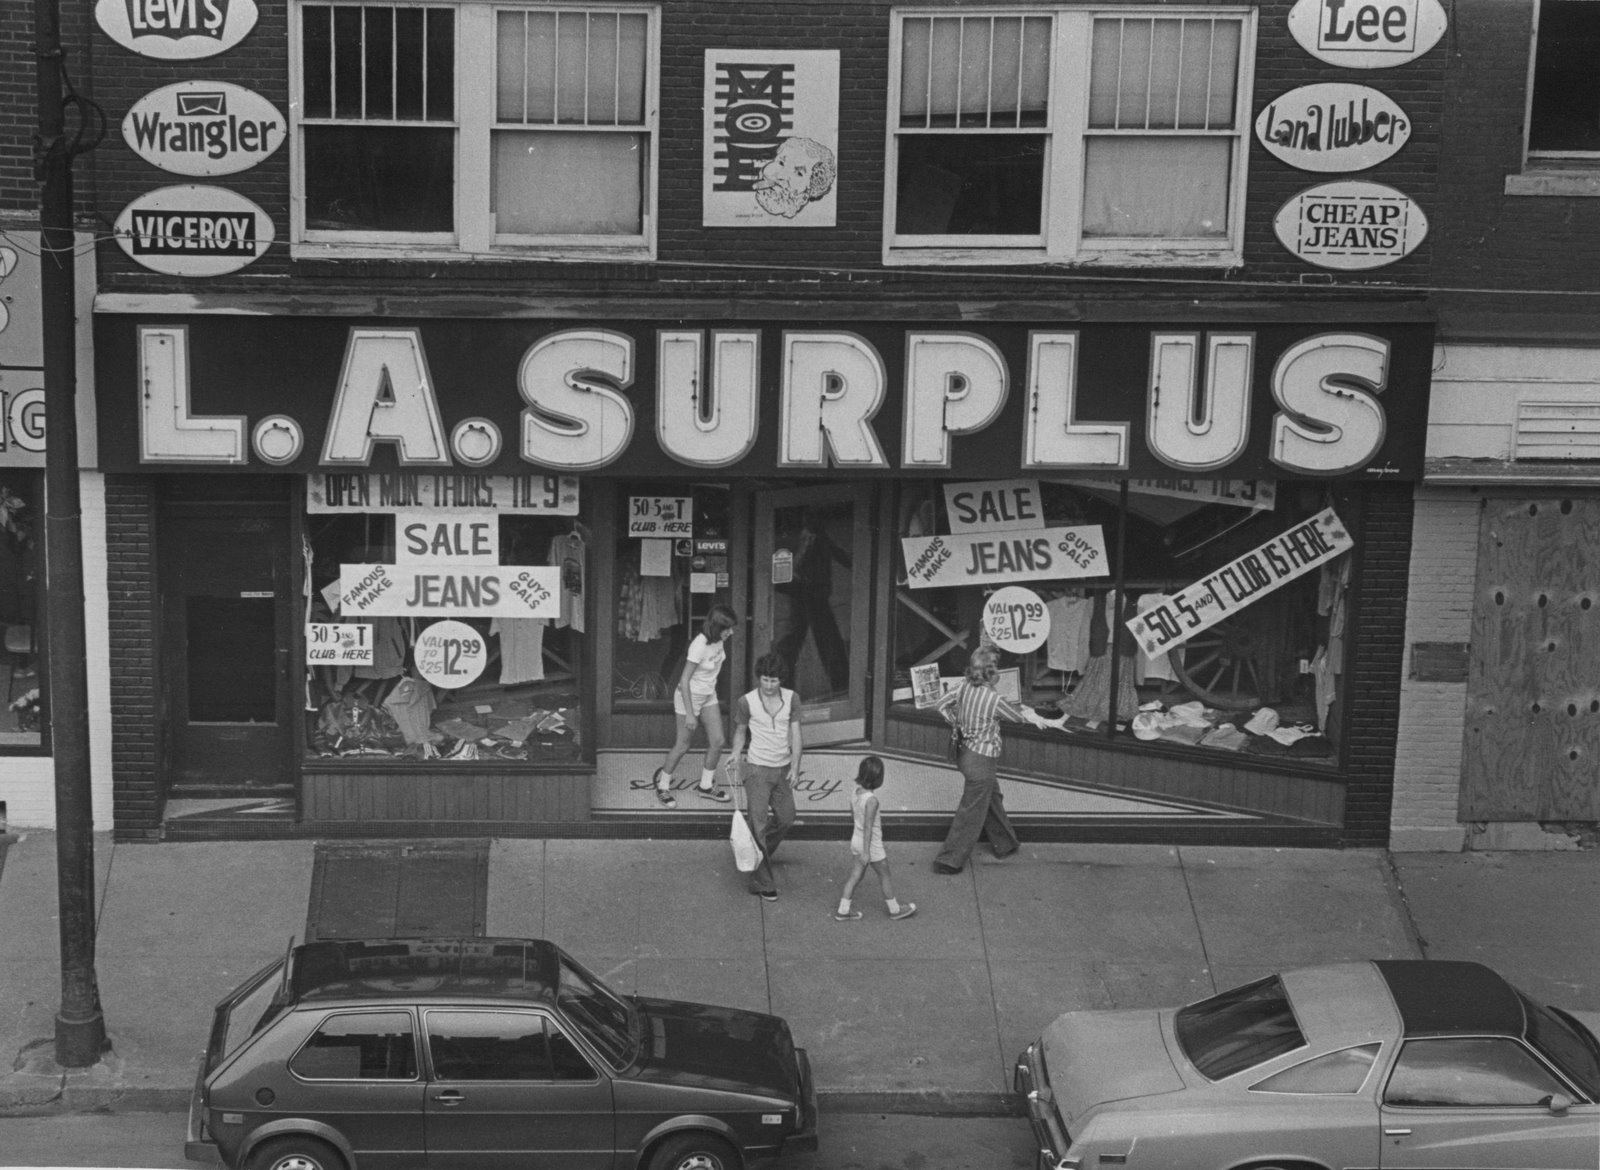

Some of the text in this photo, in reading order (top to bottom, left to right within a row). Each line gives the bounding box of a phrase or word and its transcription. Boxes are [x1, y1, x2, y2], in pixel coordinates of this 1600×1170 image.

[1324, 0, 1407, 43] Lee
[132, 112, 277, 159] Wrangler
[1306, 203, 1400, 226] CHEAP
[1304, 227, 1399, 249] JEANS
[516, 327, 1391, 477] SURPLUS
[325, 474, 370, 507] OPEN
[543, 474, 559, 508] 9
[953, 487, 1037, 524] SALE
[675, 499, 685, 520] T
[404, 523, 492, 556] SALE
[631, 521, 692, 533] CLUB HERE
[909, 536, 944, 578] FAMOUS
[966, 538, 1053, 576] JEANS
[1058, 541, 1090, 569] GALS
[1064, 531, 1099, 560] GUYS
[923, 548, 952, 582] MAKE
[1195, 593, 1213, 610] AND
[1219, 553, 1272, 603] CLUB
[1261, 543, 1291, 578] IS
[1279, 518, 1336, 569] HERE
[342, 565, 386, 606] FAMOUS
[357, 578, 393, 610] MAKE
[406, 575, 501, 607] JEANS
[509, 580, 540, 611] GALS
[517, 571, 551, 601] GUYS
[988, 602, 1008, 614] VAL
[992, 616, 1005, 625] TO
[356, 626, 366, 646] T
[422, 636, 443, 648] VAL
[990, 626, 1012, 640] $25
[309, 649, 373, 660] CLUB HERE
[418, 659, 443, 673] $25
[424, 649, 438, 659] TO
